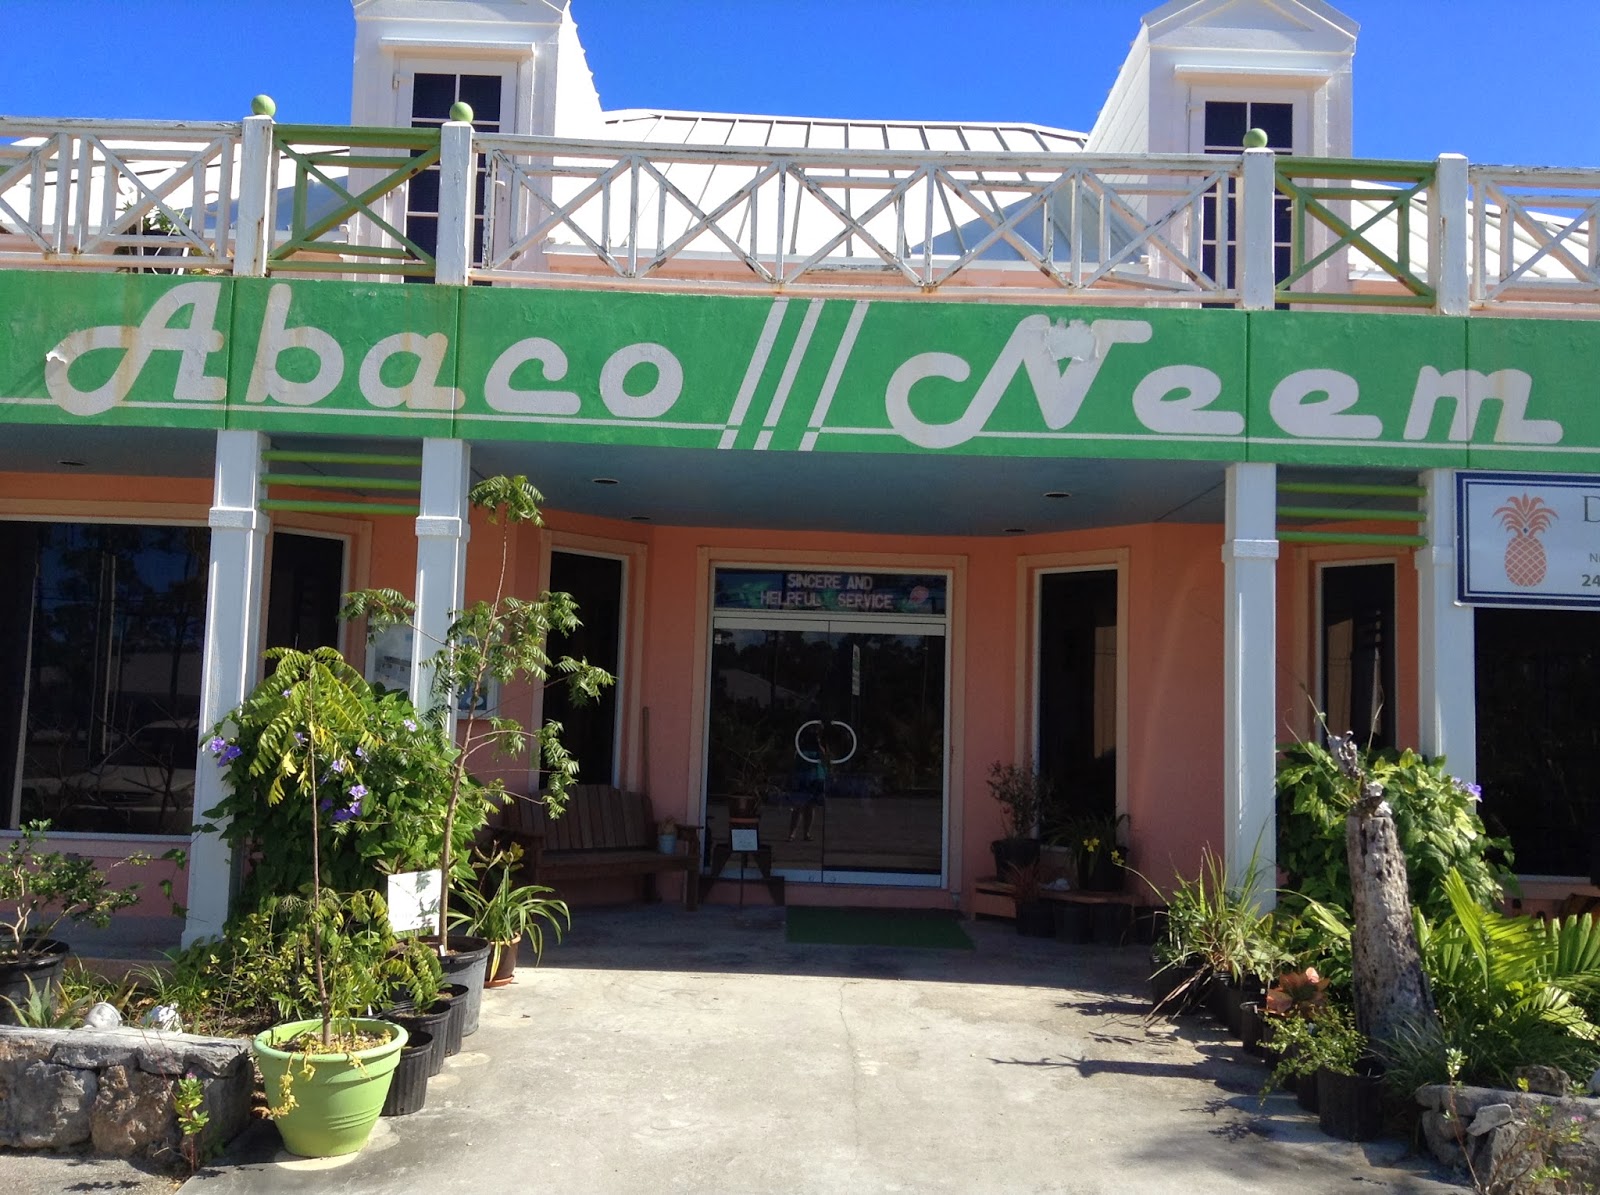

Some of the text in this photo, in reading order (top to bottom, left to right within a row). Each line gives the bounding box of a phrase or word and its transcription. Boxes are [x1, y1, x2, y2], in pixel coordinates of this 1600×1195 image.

[45, 281, 1563, 449] Abaco Neem
[787, 573, 873, 590] SINCERE AND
[760, 590, 894, 609] HELPFUL SERVICE
